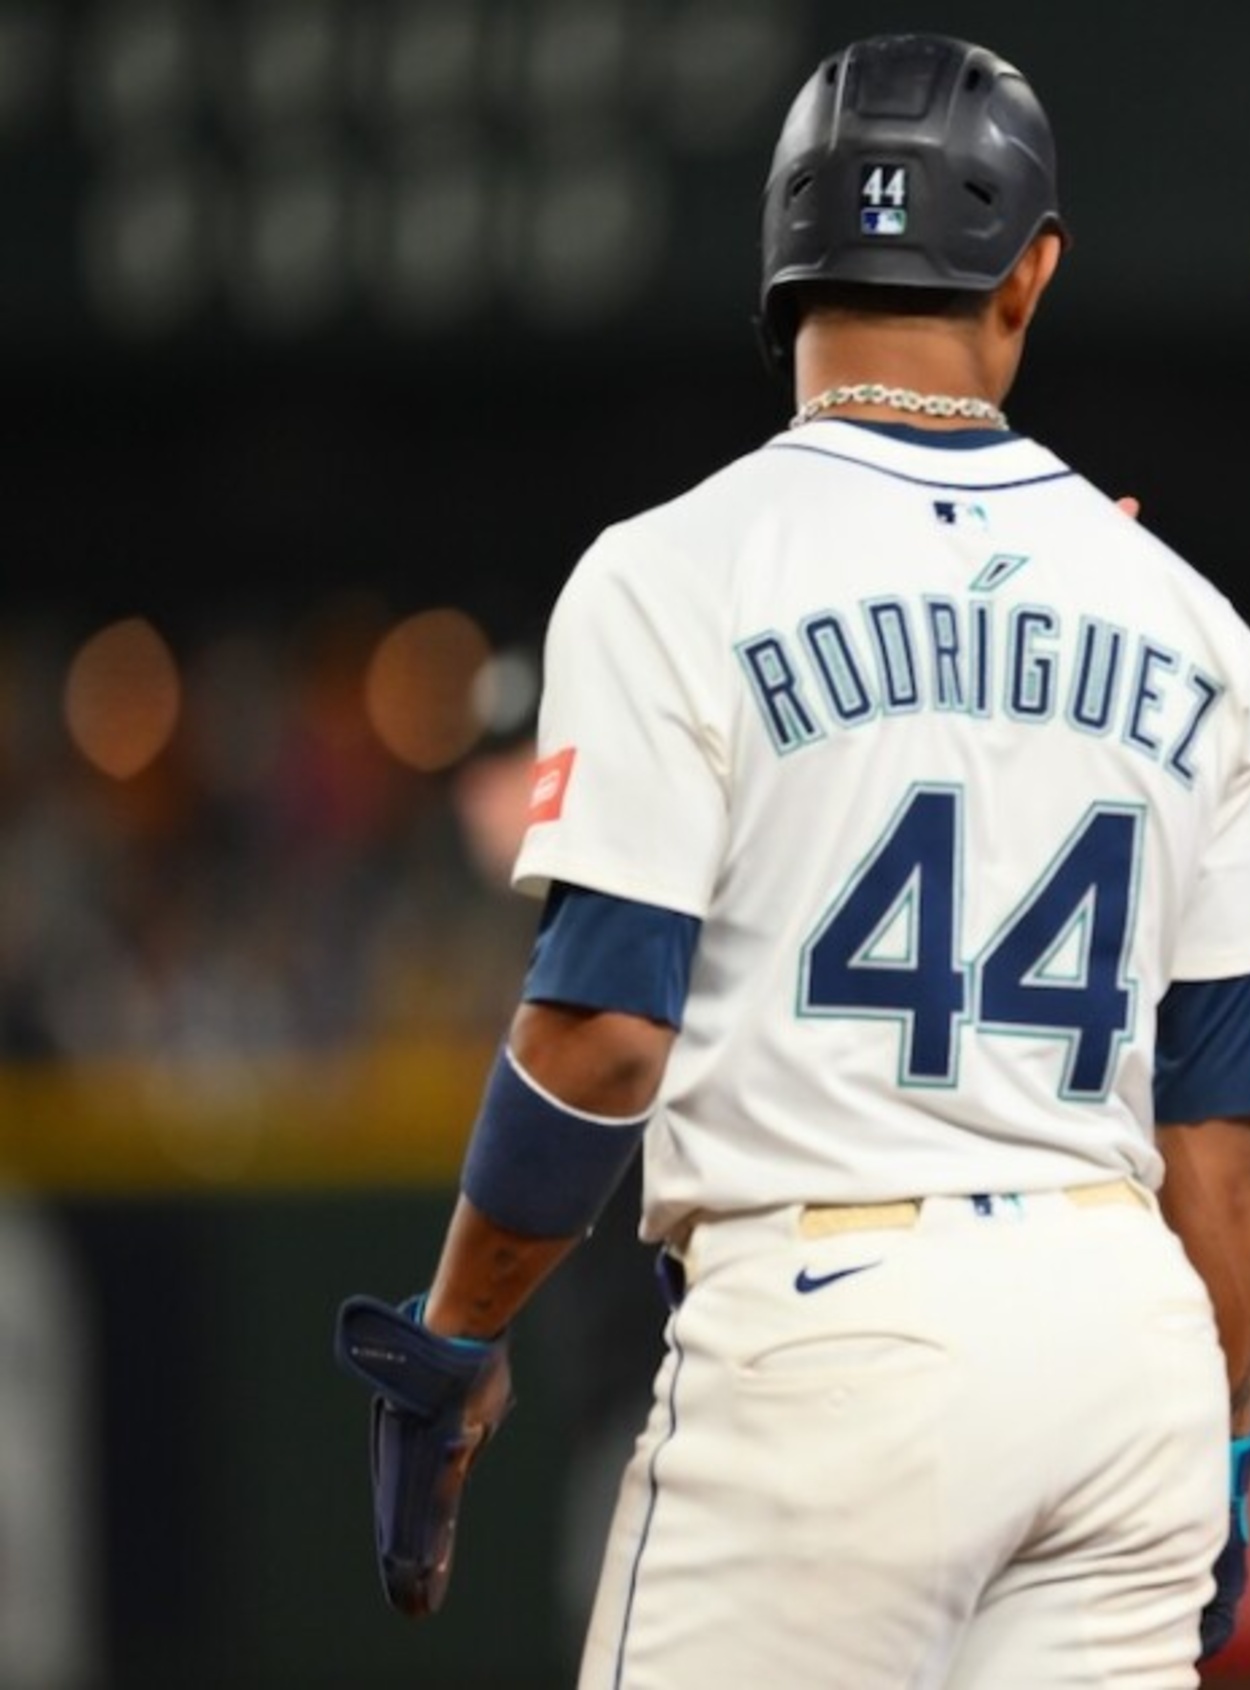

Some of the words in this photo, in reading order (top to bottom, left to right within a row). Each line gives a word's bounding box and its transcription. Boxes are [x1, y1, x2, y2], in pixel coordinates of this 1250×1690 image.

[862, 167, 906, 205] 44
[734, 553, 1226, 790] RODRÍGUEZ
[796, 781, 1148, 1104] 44
